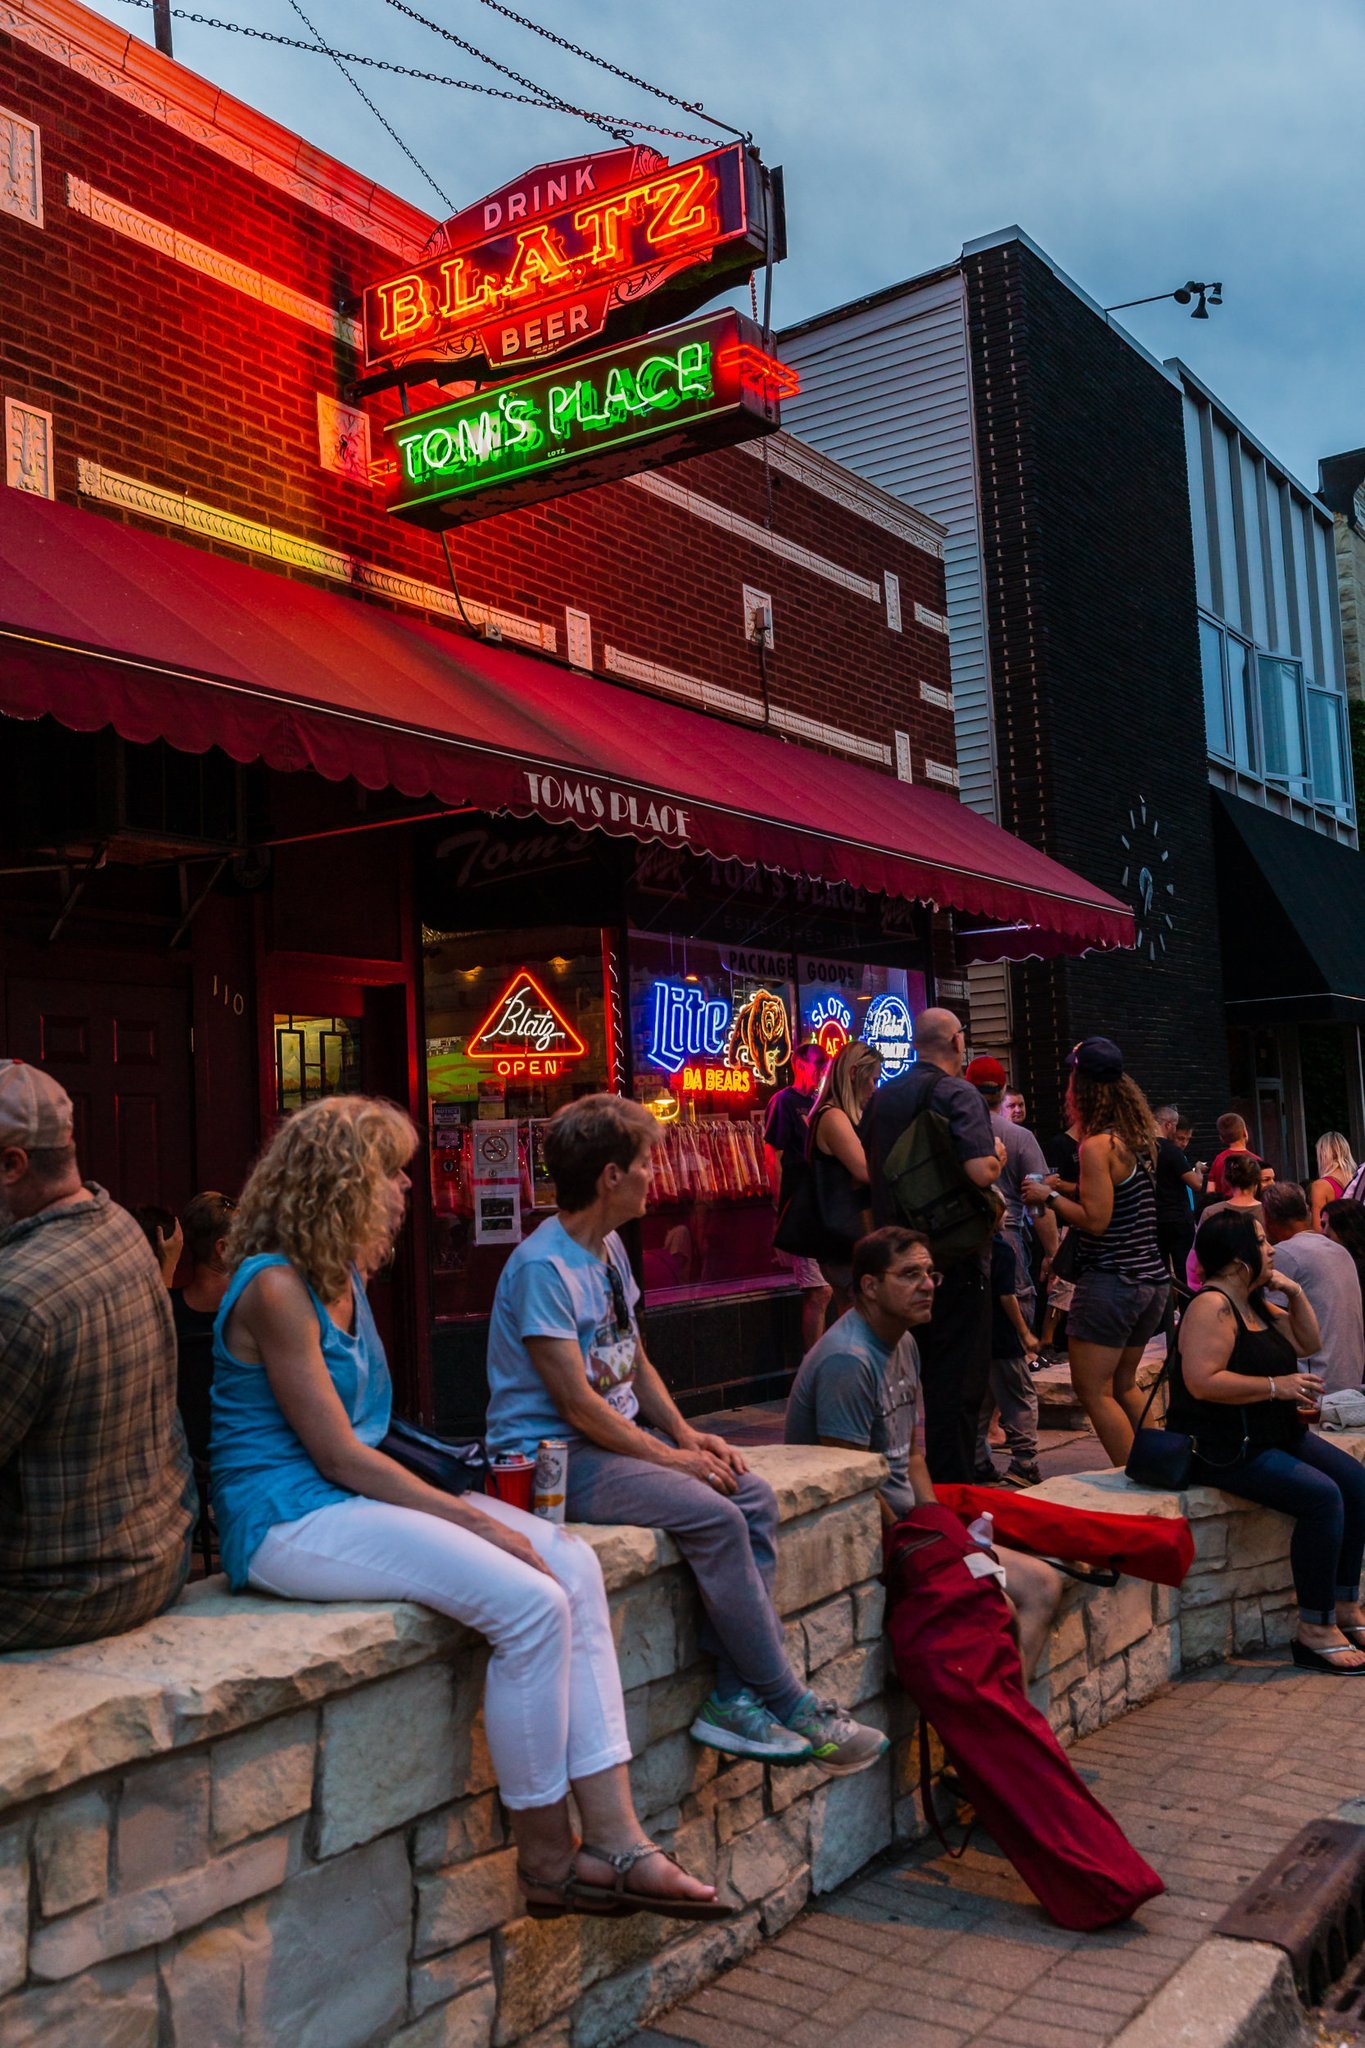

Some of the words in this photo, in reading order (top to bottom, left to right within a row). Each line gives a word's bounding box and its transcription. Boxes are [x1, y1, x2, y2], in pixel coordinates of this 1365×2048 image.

[484, 165, 596, 231] DRINK
[378, 165, 710, 340] BLATZ
[501, 304, 589, 356] BEER
[399, 394, 540, 483] TOM'S
[549, 343, 711, 437] PLACE
[523, 771, 605, 818] TOM'S
[610, 791, 691, 839] PLACE
[213, 975, 244, 1015] 110
[729, 951, 795, 978] PACKAGE
[807, 961, 854, 984] GOODS
[480, 987, 565, 1051] Blatz
[647, 982, 728, 1073] Lite
[812, 997, 851, 1029] SLOTS
[498, 1061, 556, 1075] OPEN
[683, 1067, 702, 1091] DA
[705, 1068, 750, 1093] BEARS
